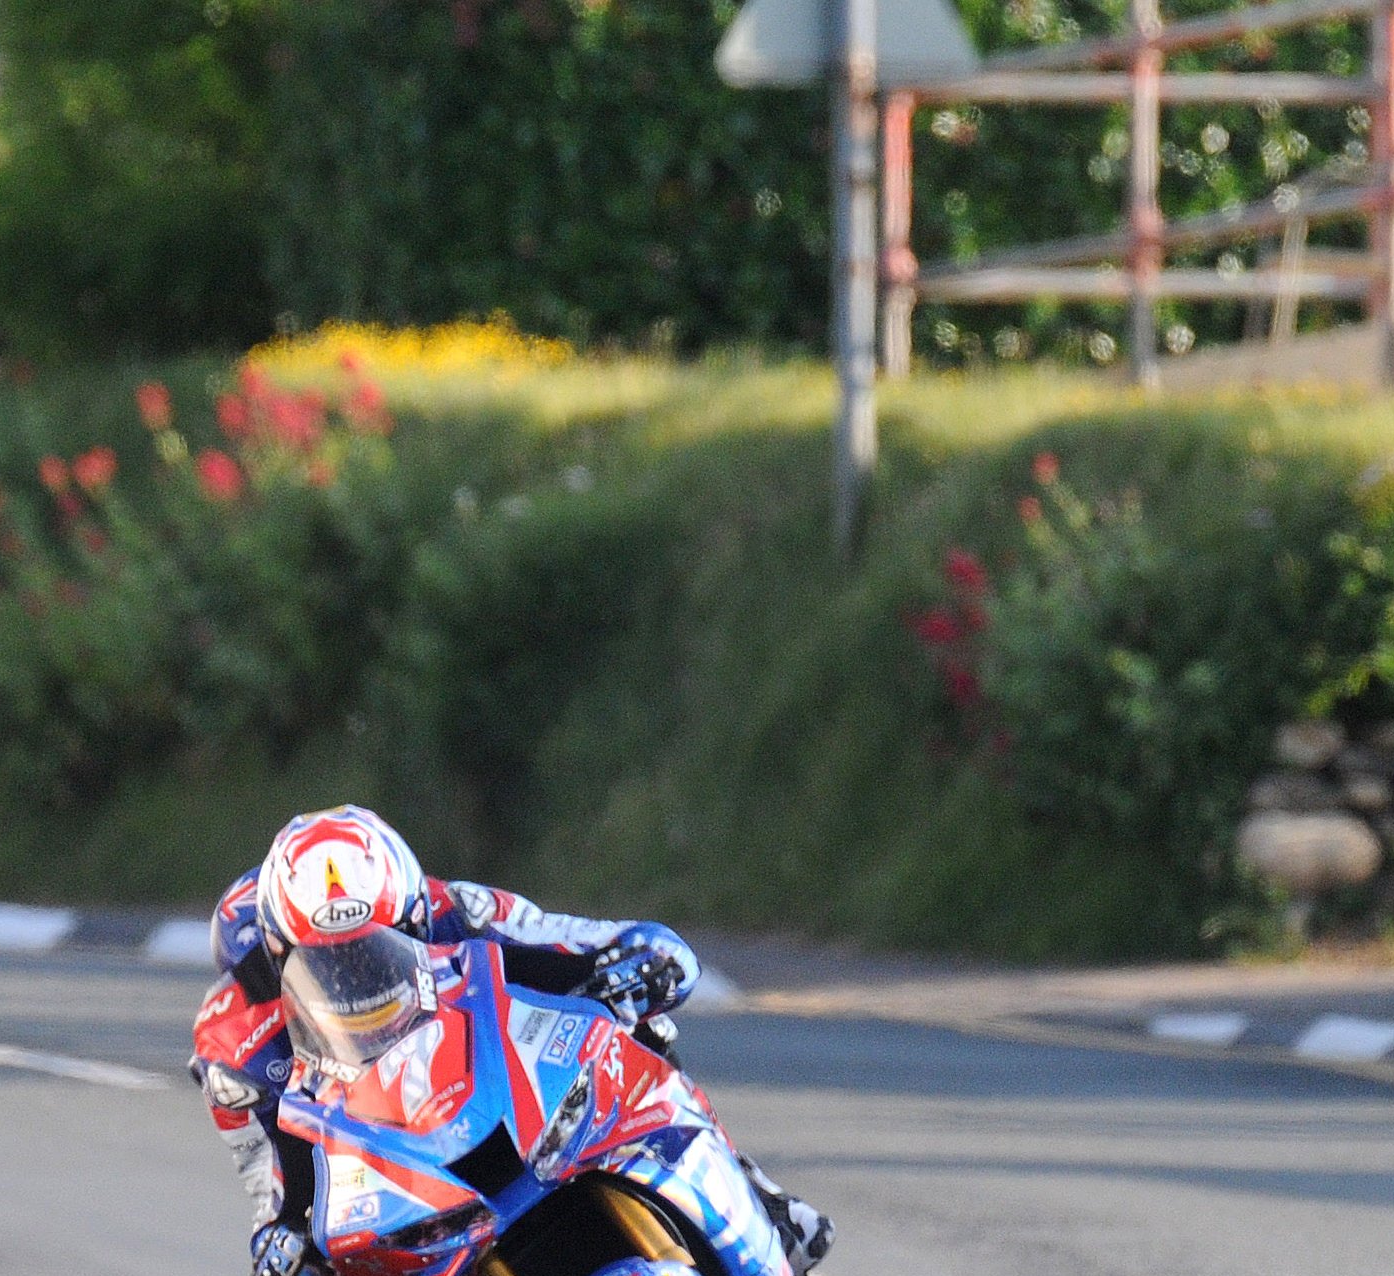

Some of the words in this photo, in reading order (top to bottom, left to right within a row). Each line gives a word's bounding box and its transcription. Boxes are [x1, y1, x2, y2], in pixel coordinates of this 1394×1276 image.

[319, 904, 363, 922] Arai
[234, 1007, 280, 1061] IXON
[376, 1019, 445, 1123] 7
